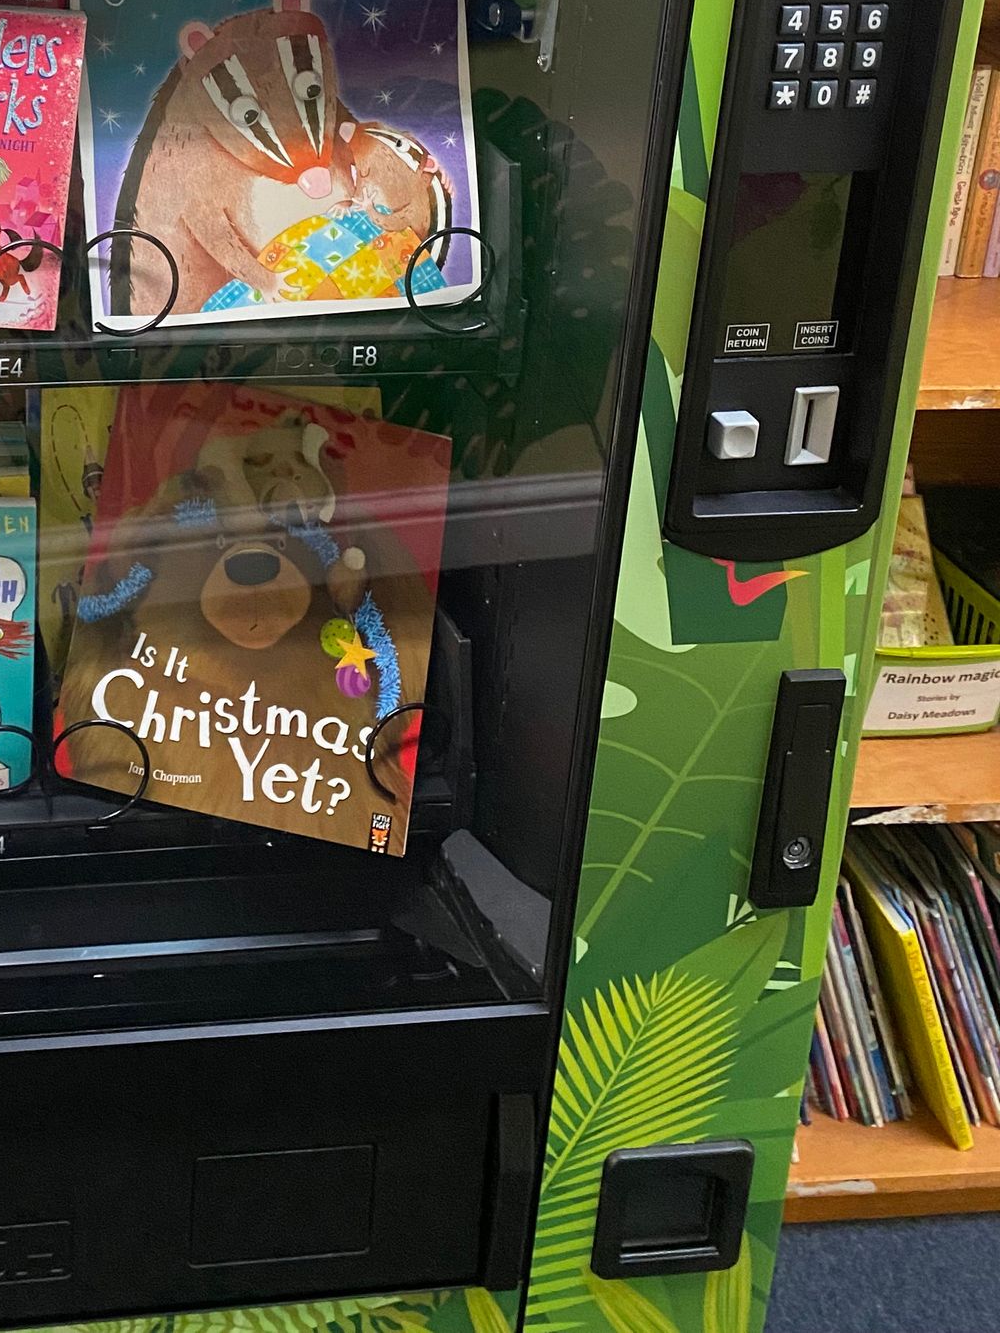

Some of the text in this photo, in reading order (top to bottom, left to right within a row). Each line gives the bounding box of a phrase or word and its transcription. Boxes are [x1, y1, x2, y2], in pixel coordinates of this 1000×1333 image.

[788, 9, 881, 31] 4 5 6
[784, 47, 876, 69] 7 8 9
[817, 85, 871, 105] 0 #
[736, 327, 760, 338] COIN
[800, 324, 834, 335] INSERT
[727, 338, 765, 348] RETURN
[801, 335, 830, 345] COINS
[352, 345, 378, 368] E8
[130, 631, 189, 684] Is It
[917, 694, 961, 703] Stories by
[91, 667, 378, 763] Christmas
[888, 709, 976, 721] Daisy Meadows
[152, 769, 202, 786] Chapman
[228, 737, 351, 816] Yet?
